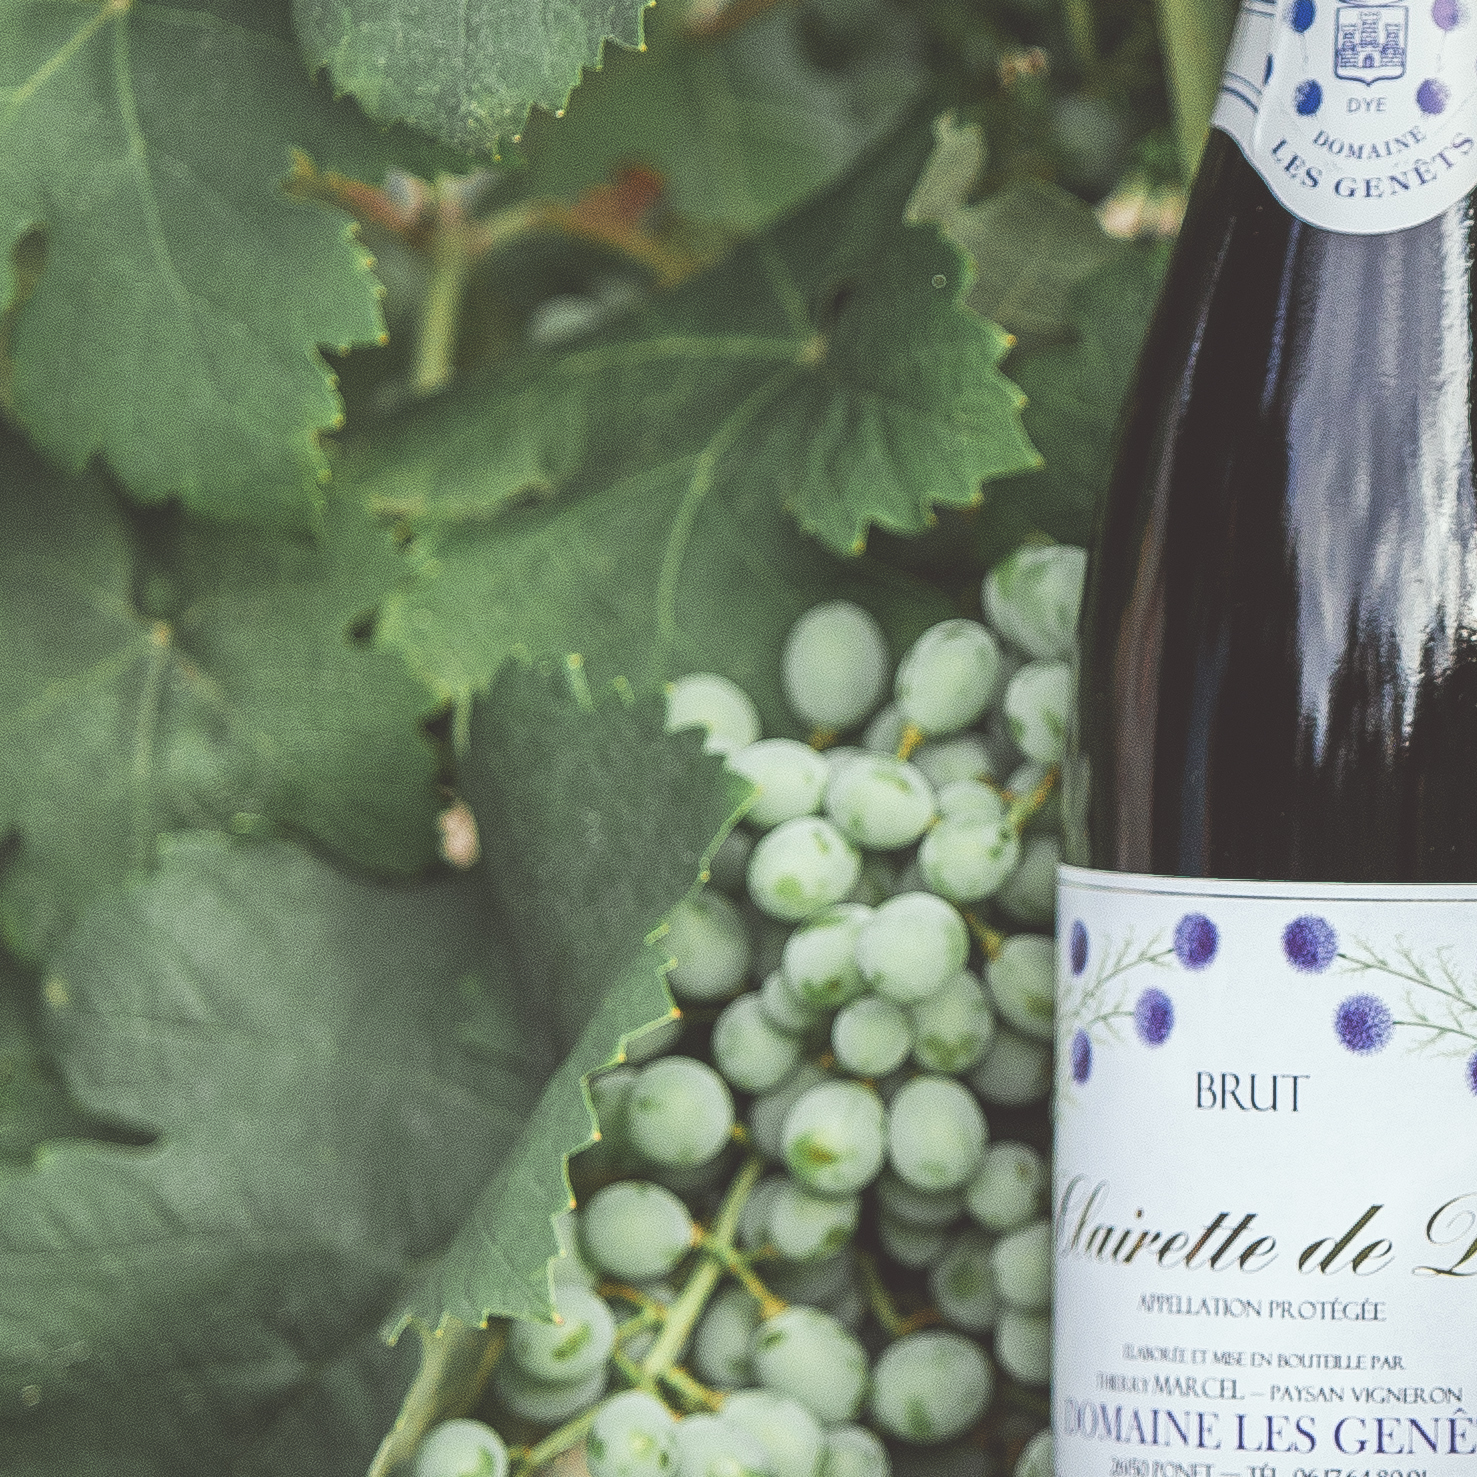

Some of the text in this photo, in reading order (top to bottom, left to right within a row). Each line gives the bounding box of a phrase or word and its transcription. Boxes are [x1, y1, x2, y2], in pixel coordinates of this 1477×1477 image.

[1346, 97, 1388, 113] DYE
[1313, 125, 1427, 160] DOMAINE
[1271, 132, 1475, 198] LES GENÊTS
[1196, 1070, 1311, 1112] BRUT
[1297, 1202, 1396, 1277] de
[1136, 1292, 1387, 1322] APPELLATION PROTÉGÉE
[1191, 1349, 1207, 1365] ET
[1212, 1350, 1247, 1367] MISE
[1250, 1352, 1272, 1368] EN
[1277, 1352, 1366, 1371] BOUTEILLE
[1370, 1355, 1406, 1370] PAR
[1151, 1375, 1245, 1401] MARCEL
[1269, 1384, 1345, 1403] PAYSAN
[1350, 1386, 1464, 1405] VIGNERON
[1064, 1397, 1221, 1450] DOMAINE
[1234, 1413, 1318, 1454] LES
